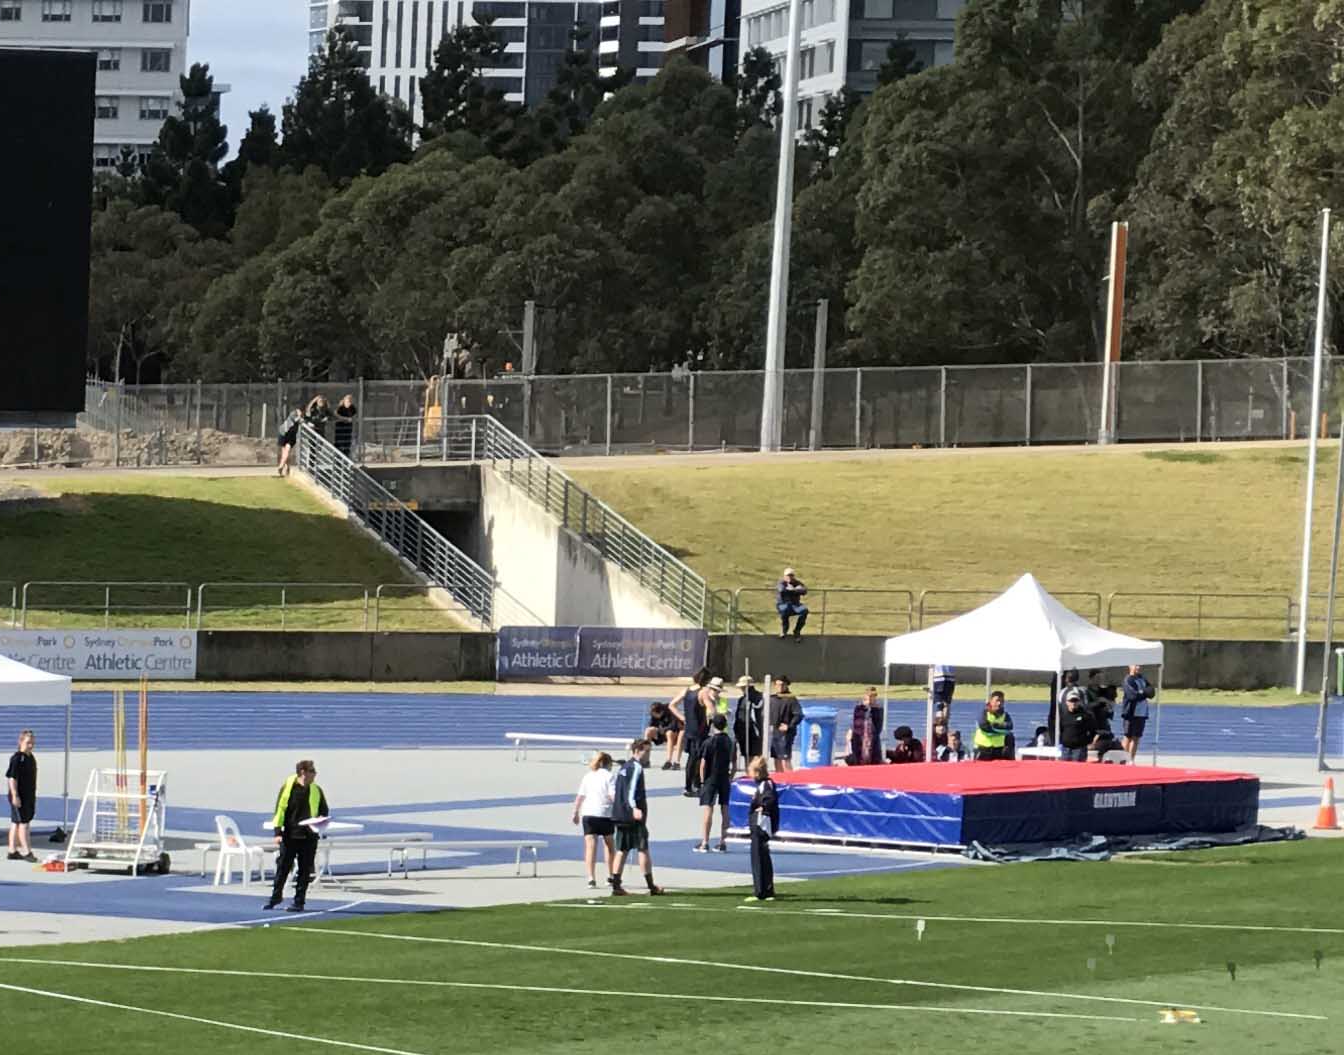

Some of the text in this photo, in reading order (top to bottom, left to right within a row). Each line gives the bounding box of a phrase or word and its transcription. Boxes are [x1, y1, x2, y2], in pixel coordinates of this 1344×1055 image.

[84, 653, 193, 672] Athletic Centre
[511, 652, 563, 669] Athletic
[590, 652, 645, 670] Athletic
[646, 654, 692, 671] Centre
